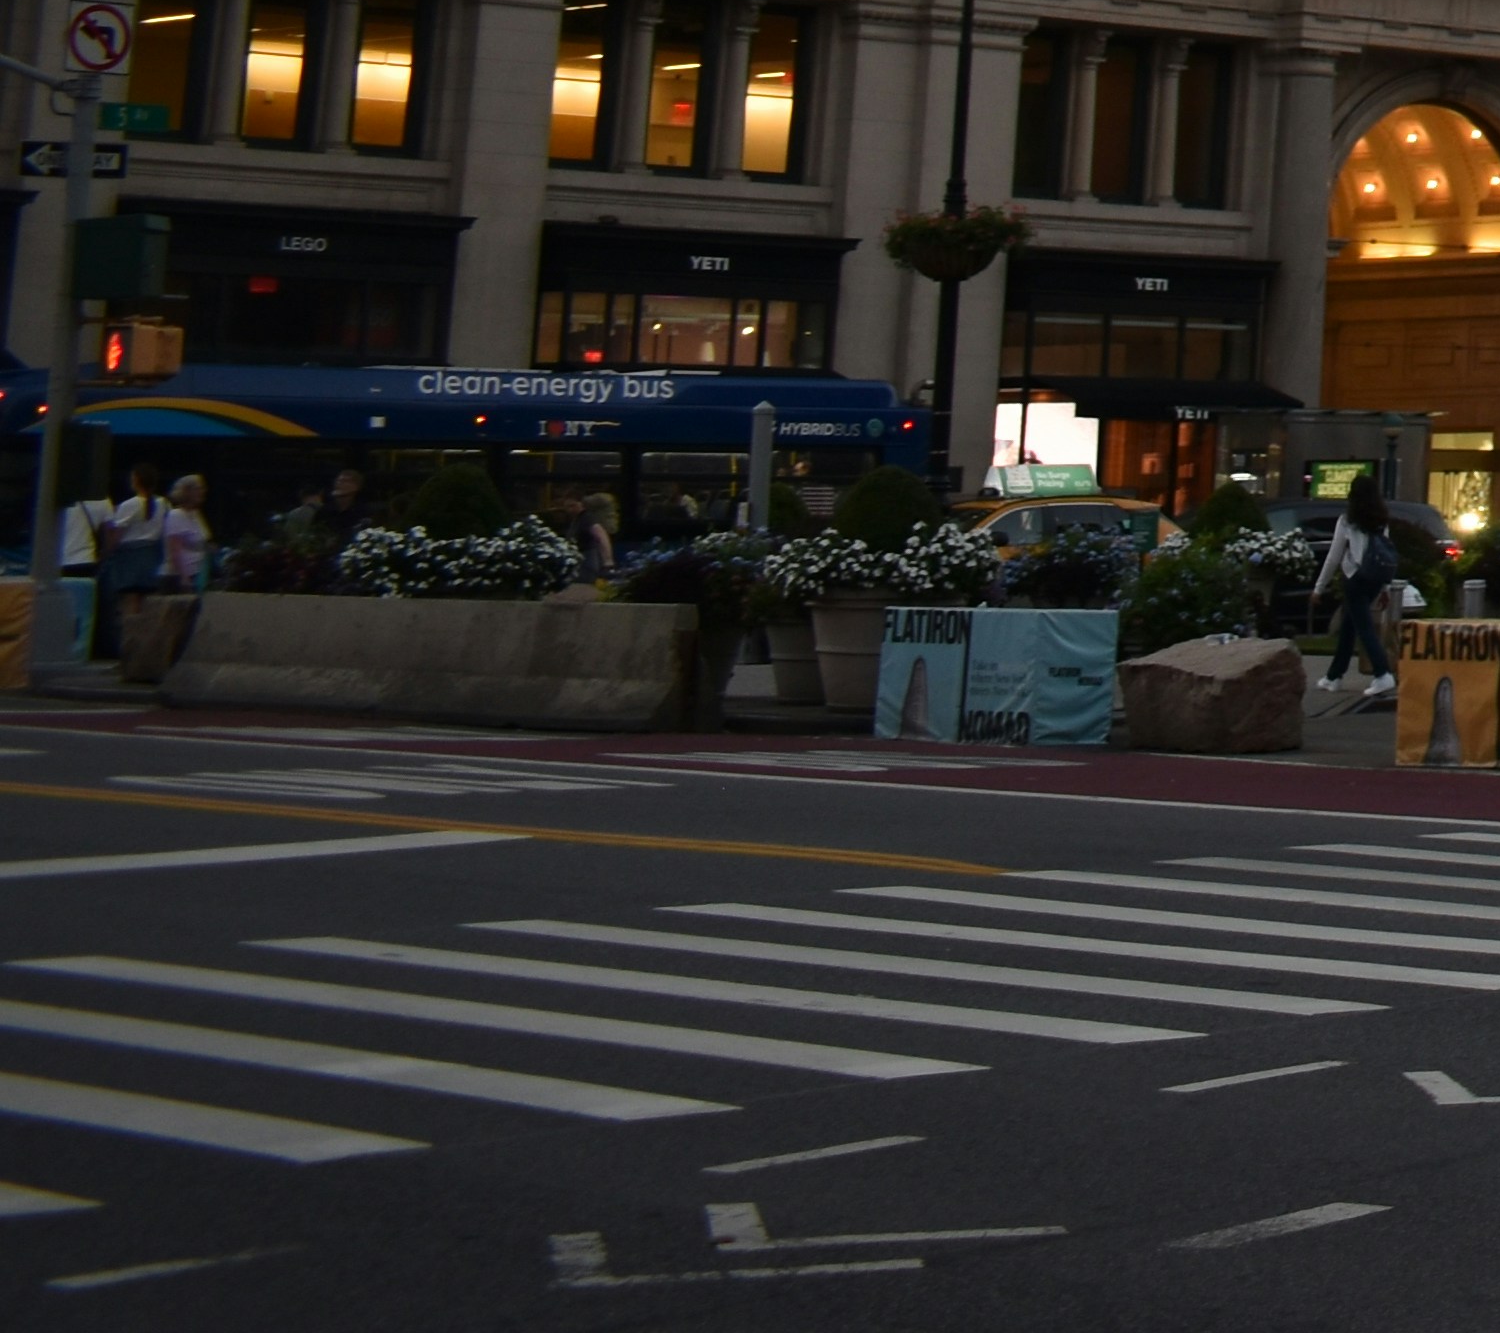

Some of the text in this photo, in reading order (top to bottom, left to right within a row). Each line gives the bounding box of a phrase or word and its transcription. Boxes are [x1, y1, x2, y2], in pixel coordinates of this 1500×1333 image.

[281, 236, 328, 252] LEGO
[689, 255, 730, 271] YETI
[1135, 277, 1169, 291] YETI
[418, 371, 675, 404] clean-energy bus
[883, 609, 972, 644] FLATIRON
